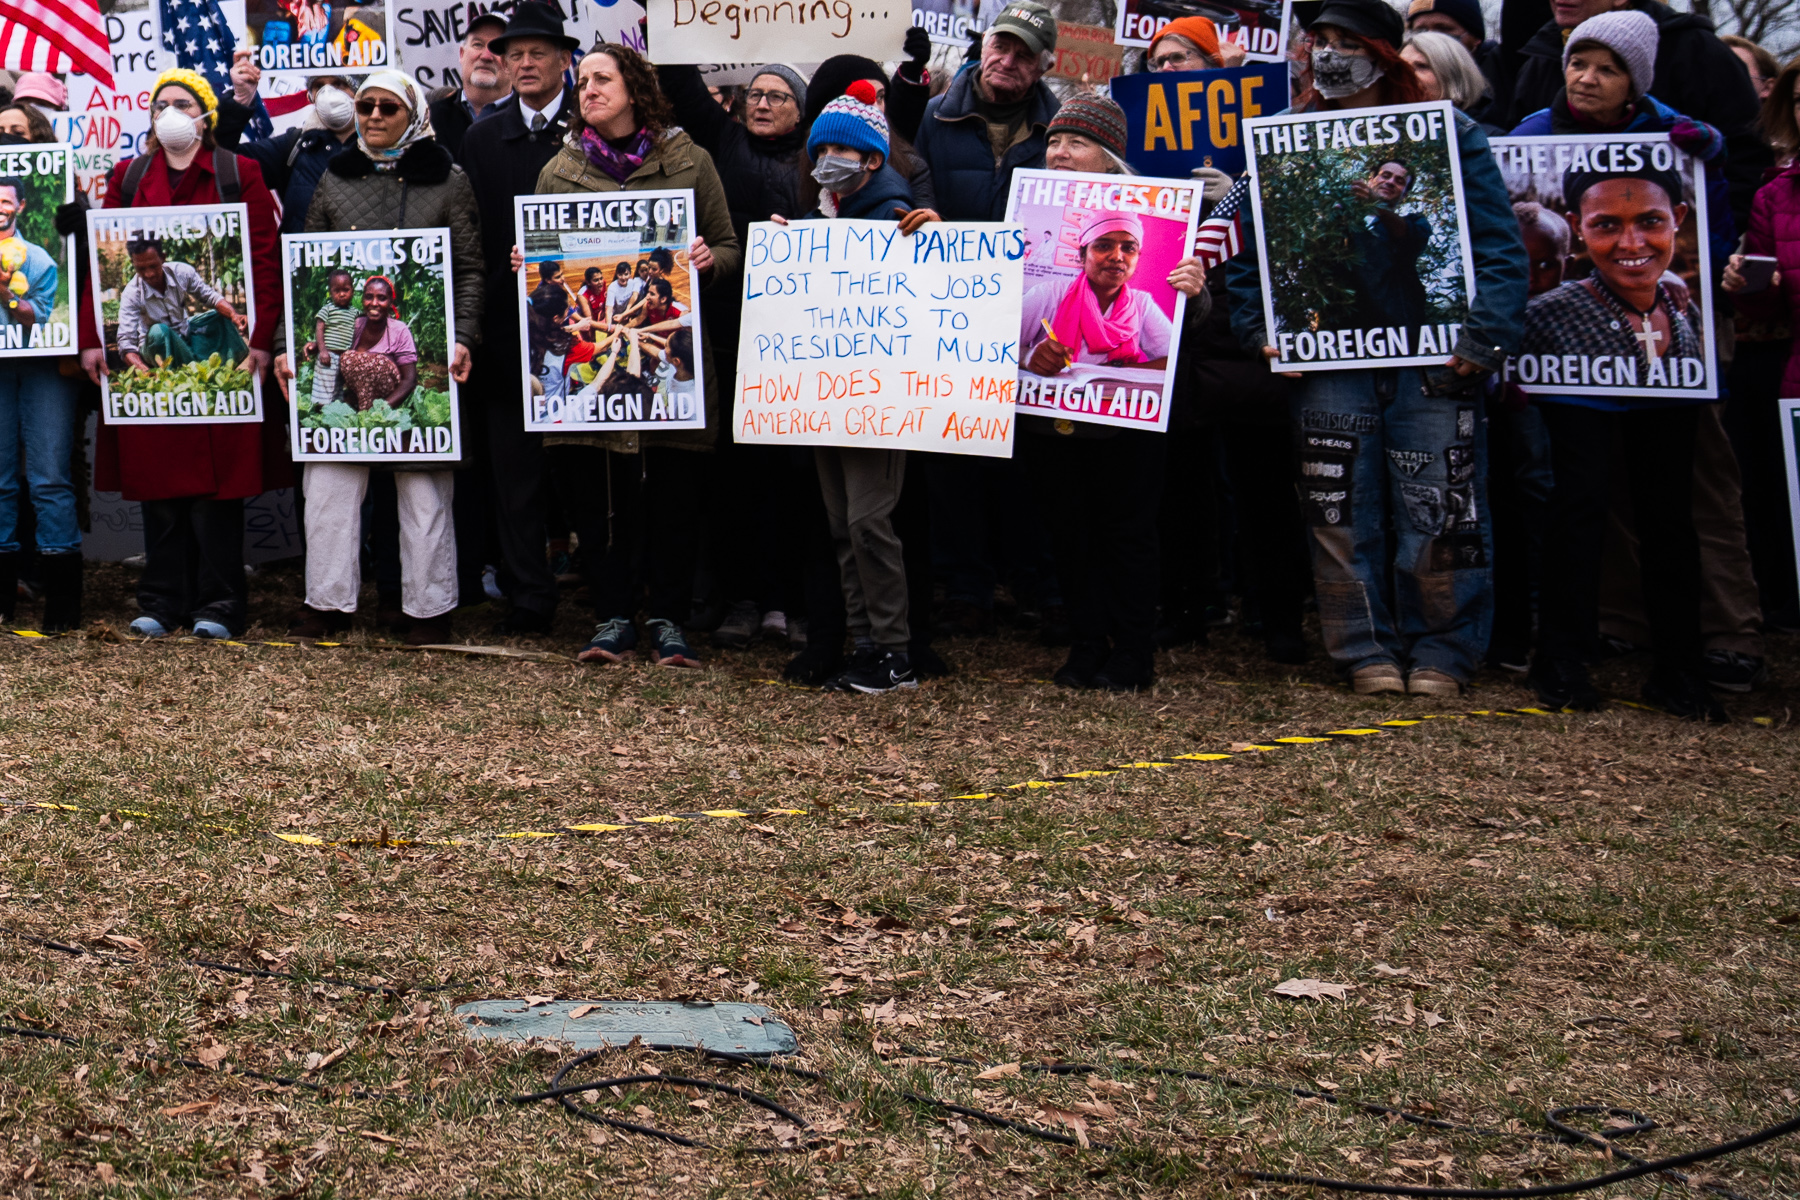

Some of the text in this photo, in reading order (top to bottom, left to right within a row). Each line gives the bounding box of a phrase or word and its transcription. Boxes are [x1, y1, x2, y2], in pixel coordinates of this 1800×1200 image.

[397, 2, 464, 48] SAVE
[912, 8, 983, 38] OREIGN
[1030, 15, 1044, 29] ACT
[250, 40, 386, 70] FOREIGN AID
[1236, 26, 1278, 54] AID
[1253, 111, 1443, 155] THE FACES OF
[36, 151, 65, 176] OF
[1493, 143, 1690, 173] THE FACES OF
[1021, 177, 1191, 217] THE FACES OF
[95, 212, 238, 241] THE FACES OF
[523, 198, 685, 230] THE FACES OF
[290, 237, 441, 267] THE FACES OF
[577, 237, 602, 245] USAID
[751, 225, 1025, 267] BOTH MY PARENTS
[747, 271, 1002, 300] LOST THEIR JOBS
[804, 306, 969, 330] THANKS TO
[29, 322, 70, 349] AID
[754, 332, 1019, 365] PRESIDENT MUSK
[1279, 326, 1410, 362] FOREIGN
[1504, 354, 1705, 388] FOREIGN AID
[742, 368, 1017, 405] HOW DOES THIS MAKE
[1019, 376, 1161, 419] REIGN AID
[111, 390, 254, 417] FOREIGN AID
[533, 392, 695, 422] FOREIGN AID
[742, 405, 1010, 442] AMERICA GREAT AGAIN
[300, 426, 451, 453] FOREIGN AID
